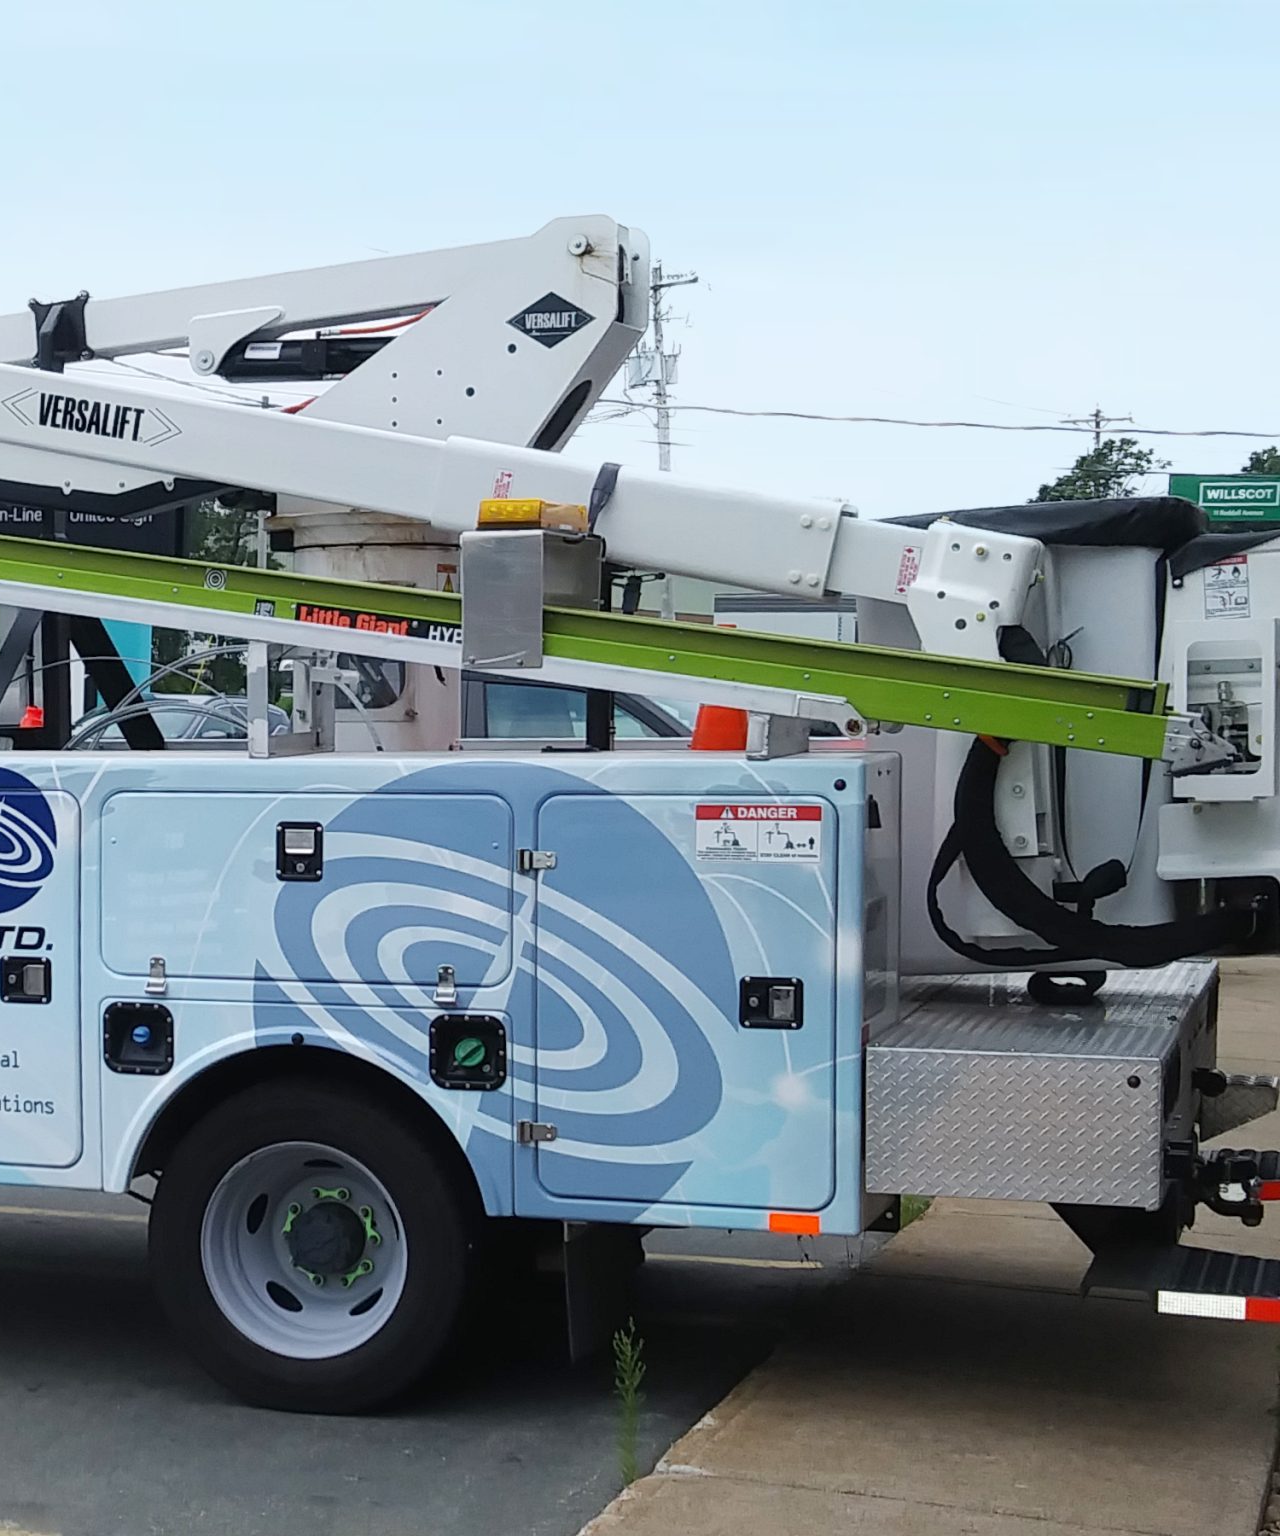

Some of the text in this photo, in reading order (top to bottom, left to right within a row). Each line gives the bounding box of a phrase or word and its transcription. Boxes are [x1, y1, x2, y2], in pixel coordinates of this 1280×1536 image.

[524, 311, 577, 330] VERSALIFT
[38, 392, 145, 442] VERSALIFT
[1206, 488, 1274, 499] WILLSCOT
[299, 606, 351, 628] Little
[356, 614, 409, 636] Giant
[737, 807, 798, 819] DANGER
